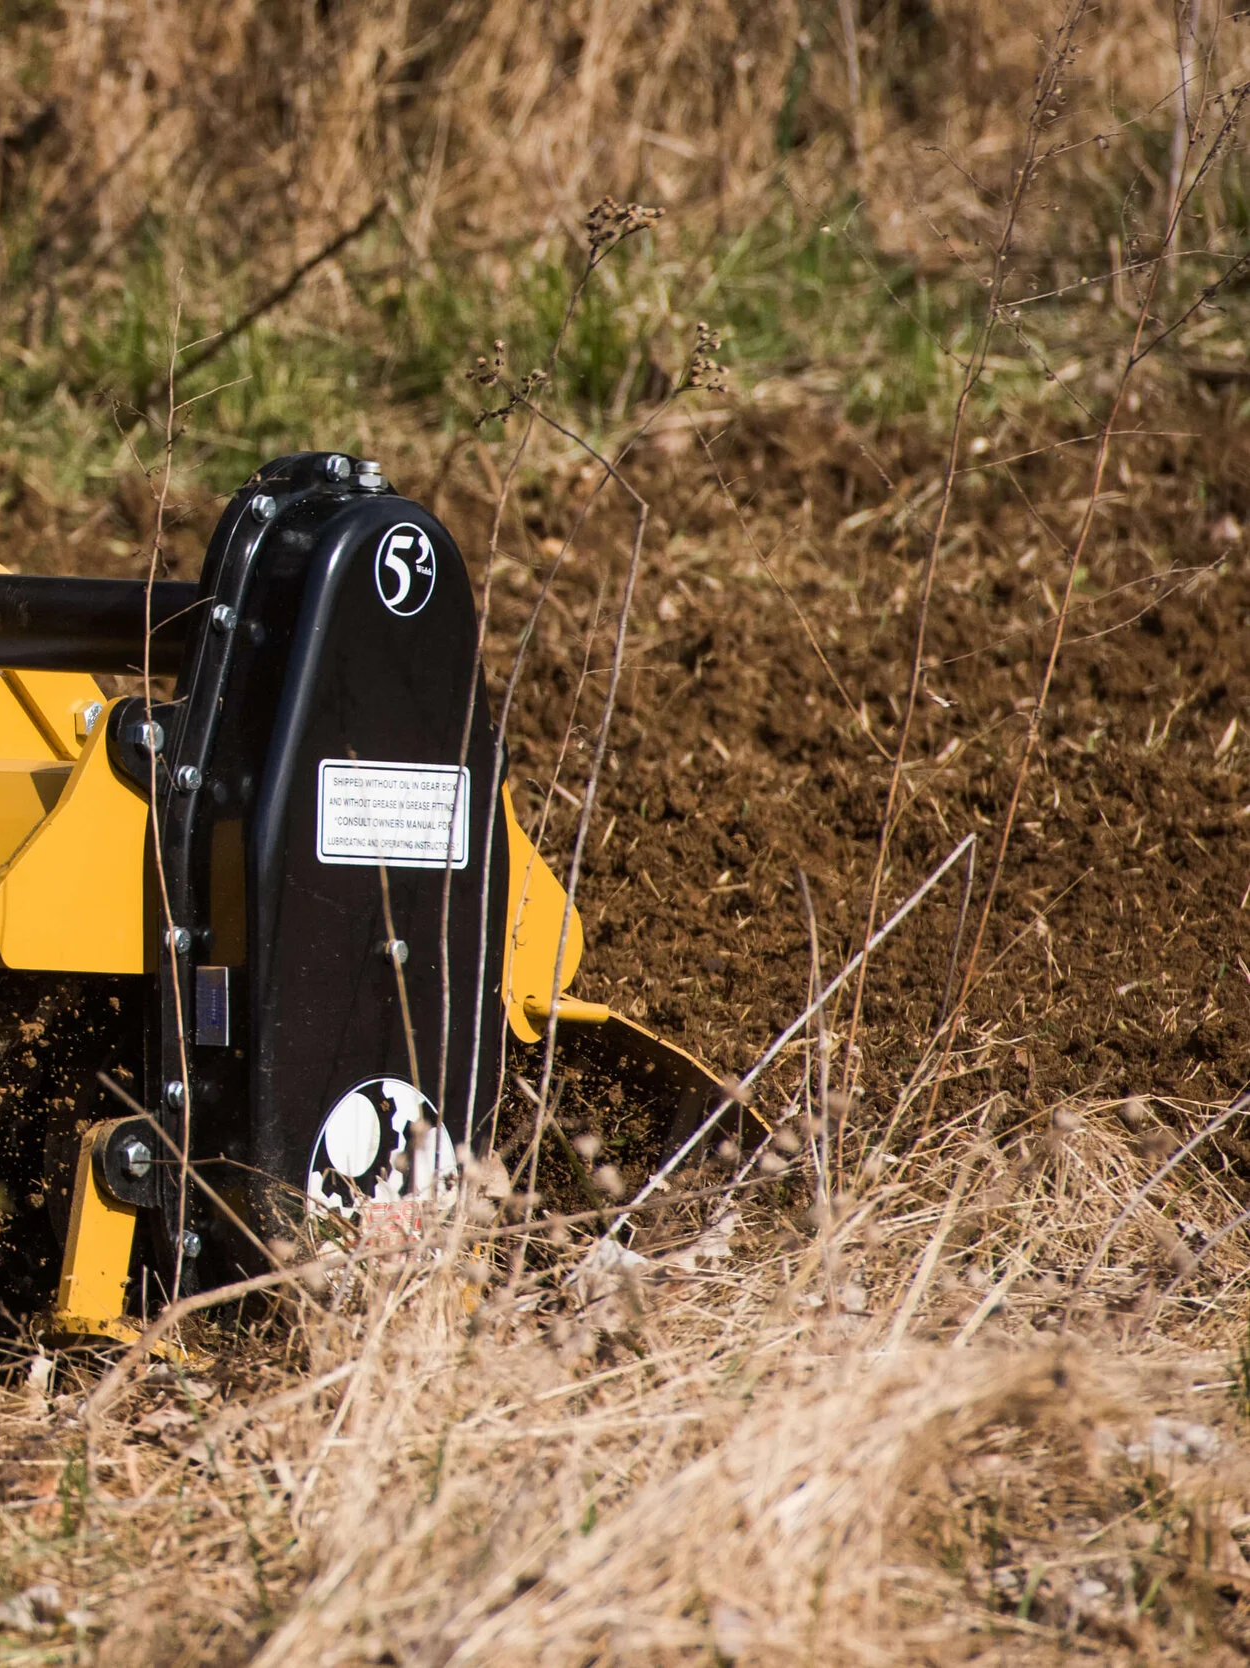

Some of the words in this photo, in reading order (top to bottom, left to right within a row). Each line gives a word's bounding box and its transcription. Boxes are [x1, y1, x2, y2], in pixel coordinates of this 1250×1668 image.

[334, 778, 363, 787] SHIPPED
[366, 779, 397, 789] WITHOUT
[399, 781, 410, 789] OIL
[412, 781, 418, 790] IN
[421, 782, 440, 791] GEAR
[329, 798, 342, 806] AND
[343, 798, 371, 807] WITHOUT
[373, 800, 397, 808] GREASE
[406, 801, 430, 810] GREASE
[373, 818, 404, 828] OWNERS
[406, 820, 435, 830] MANUAL
[328, 837, 365, 846] LUBRICATING
[368, 838, 378, 847] AND
[381, 839, 413, 849] OPERATING
